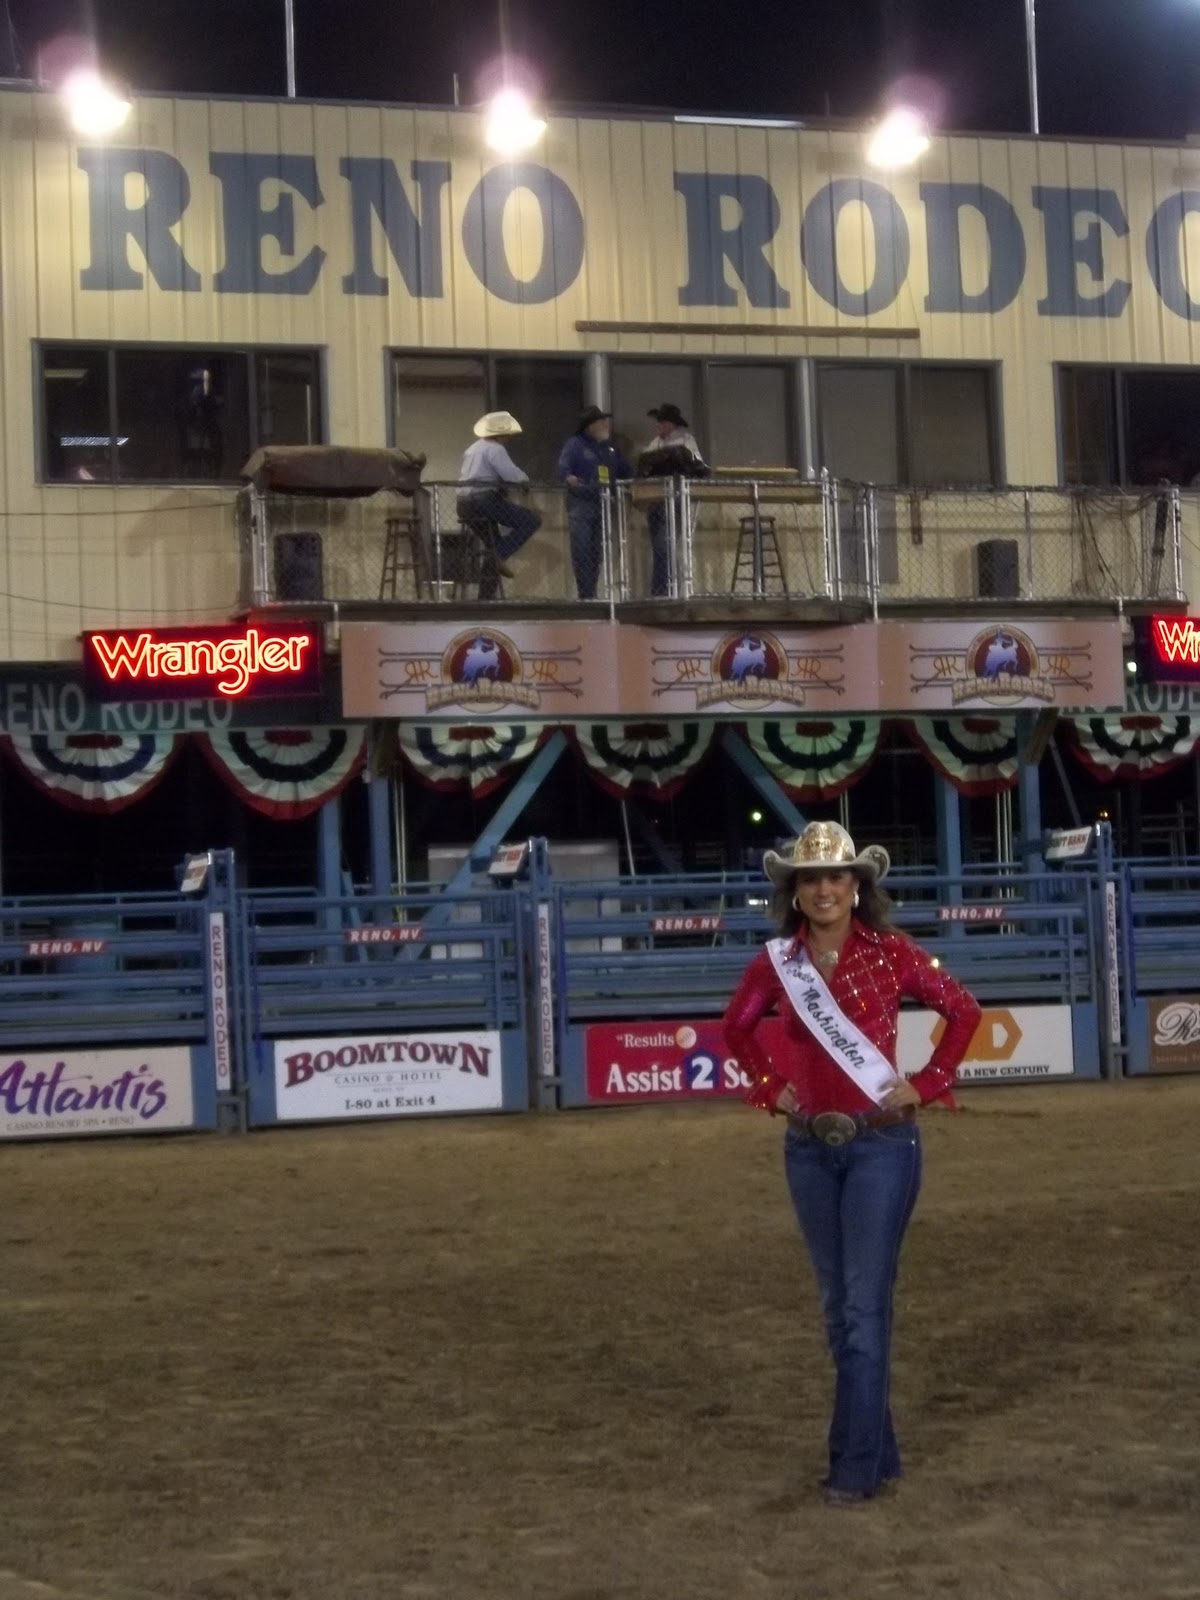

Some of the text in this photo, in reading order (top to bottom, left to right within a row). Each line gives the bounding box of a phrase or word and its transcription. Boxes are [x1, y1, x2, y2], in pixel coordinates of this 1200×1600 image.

[77, 147, 585, 304] RENO
[92, 629, 309, 695] Wrangler
[0, 683, 86, 732] ENO
[701, 918, 720, 929] NV
[984, 907, 1003, 918] NV
[82, 940, 103, 953] NV
[400, 927, 421, 941] NV
[212, 925, 228, 1077] RENO RODEO
[538, 917, 553, 1065] RENO RODEO
[284, 1040, 493, 1088] BOOMTOWN
[334, 1072, 442, 1085] CASINO HOTEL
[606, 1063, 682, 1093] Assist
[691, 1056, 714, 1090] 2
[974, 1067, 998, 1076] NEW
[1000, 1065, 1050, 1075] CENTURY
[0, 1060, 167, 1120] Atlantis
[345, 1095, 436, 1110] I-80 at Exit 4
